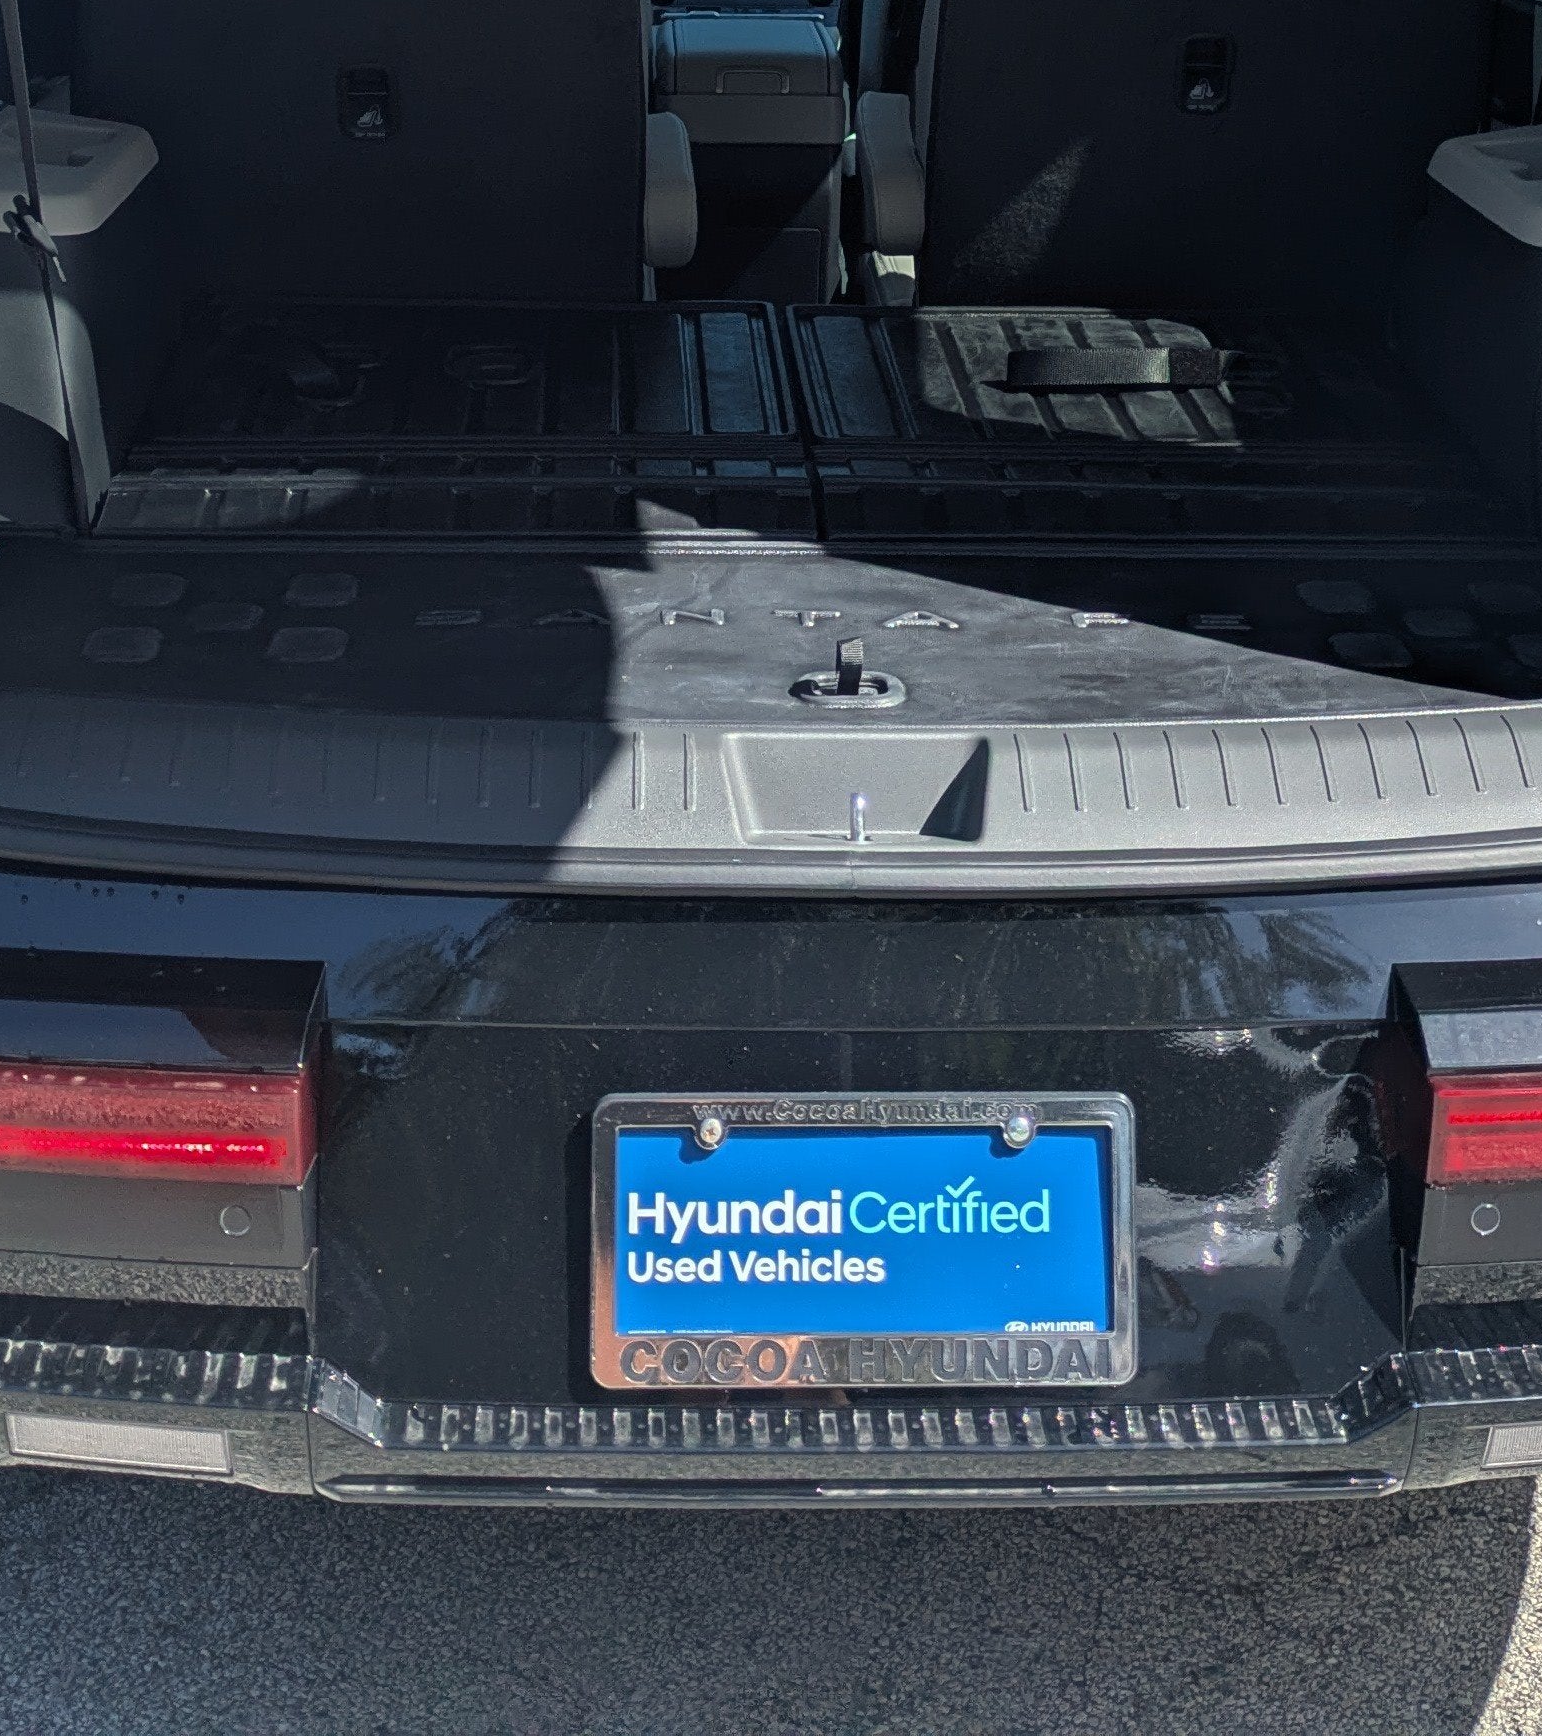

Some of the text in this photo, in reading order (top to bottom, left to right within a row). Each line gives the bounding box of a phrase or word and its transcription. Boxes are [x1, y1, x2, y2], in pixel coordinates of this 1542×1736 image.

[628, 1176, 1051, 1244] Hyundai Certified
[628, 1248, 886, 1283] Used Vehicles
[1031, 1321, 1095, 1332] HYUNDAI
[619, 1337, 1114, 1384] COCOA HYUNDAI
